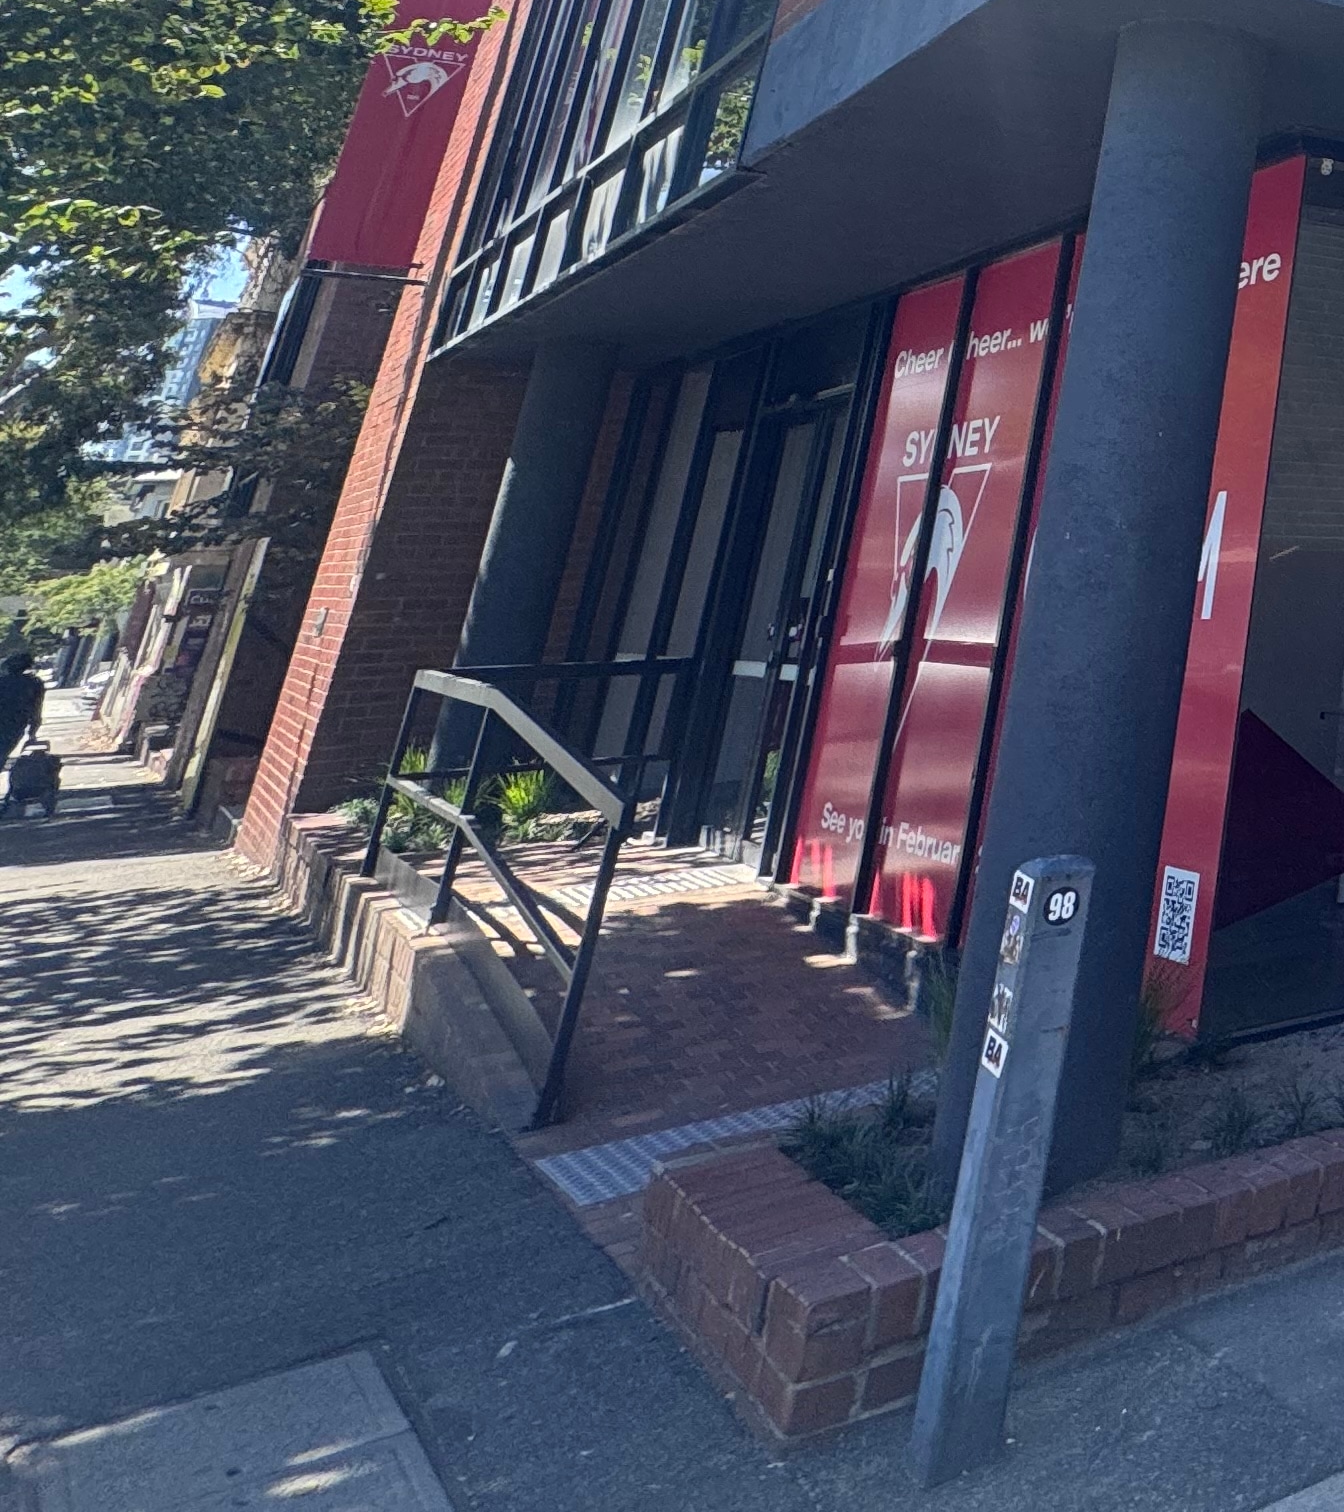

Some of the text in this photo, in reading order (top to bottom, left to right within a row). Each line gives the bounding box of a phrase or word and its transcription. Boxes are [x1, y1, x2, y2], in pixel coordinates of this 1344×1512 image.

[388, 45, 468, 62] SYDNEY
[894, 327, 1022, 379] Cheer heer...
[821, 801, 847, 835] See
[845, 816, 865, 844] yo
[878, 816, 894, 845] in
[896, 822, 961, 865] Februar
[1048, 891, 1077, 921] 98
